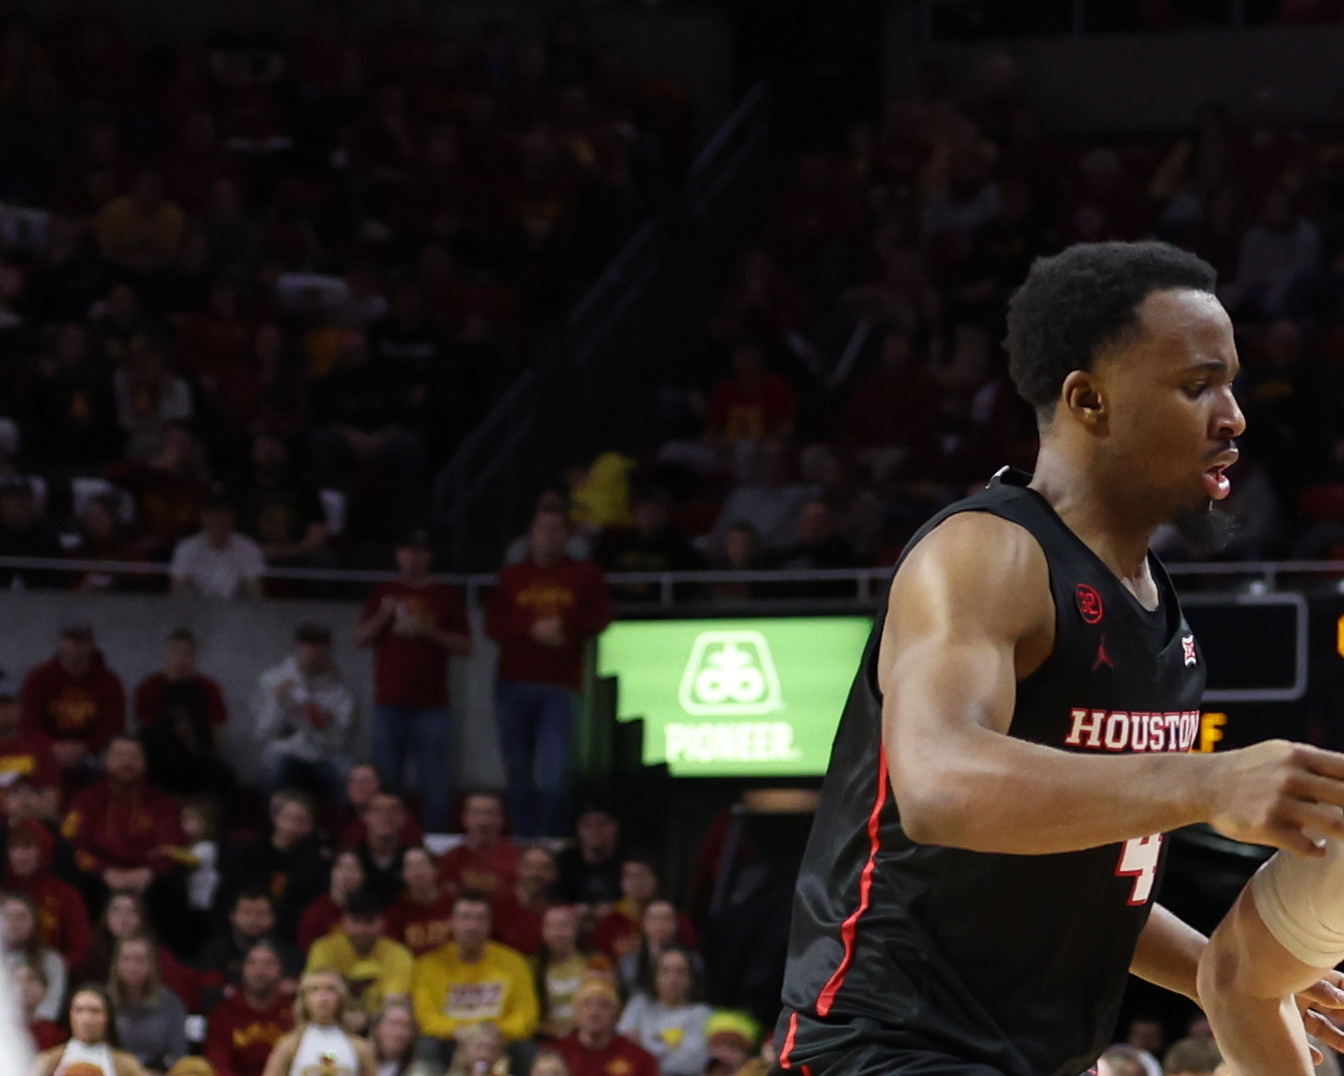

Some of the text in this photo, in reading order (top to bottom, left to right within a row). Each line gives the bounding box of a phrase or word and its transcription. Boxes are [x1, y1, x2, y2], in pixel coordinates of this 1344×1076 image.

[665, 721, 794, 763] PIONEER
[1063, 707, 1200, 752] HOUSTON
[1114, 832, 1165, 906] 4
